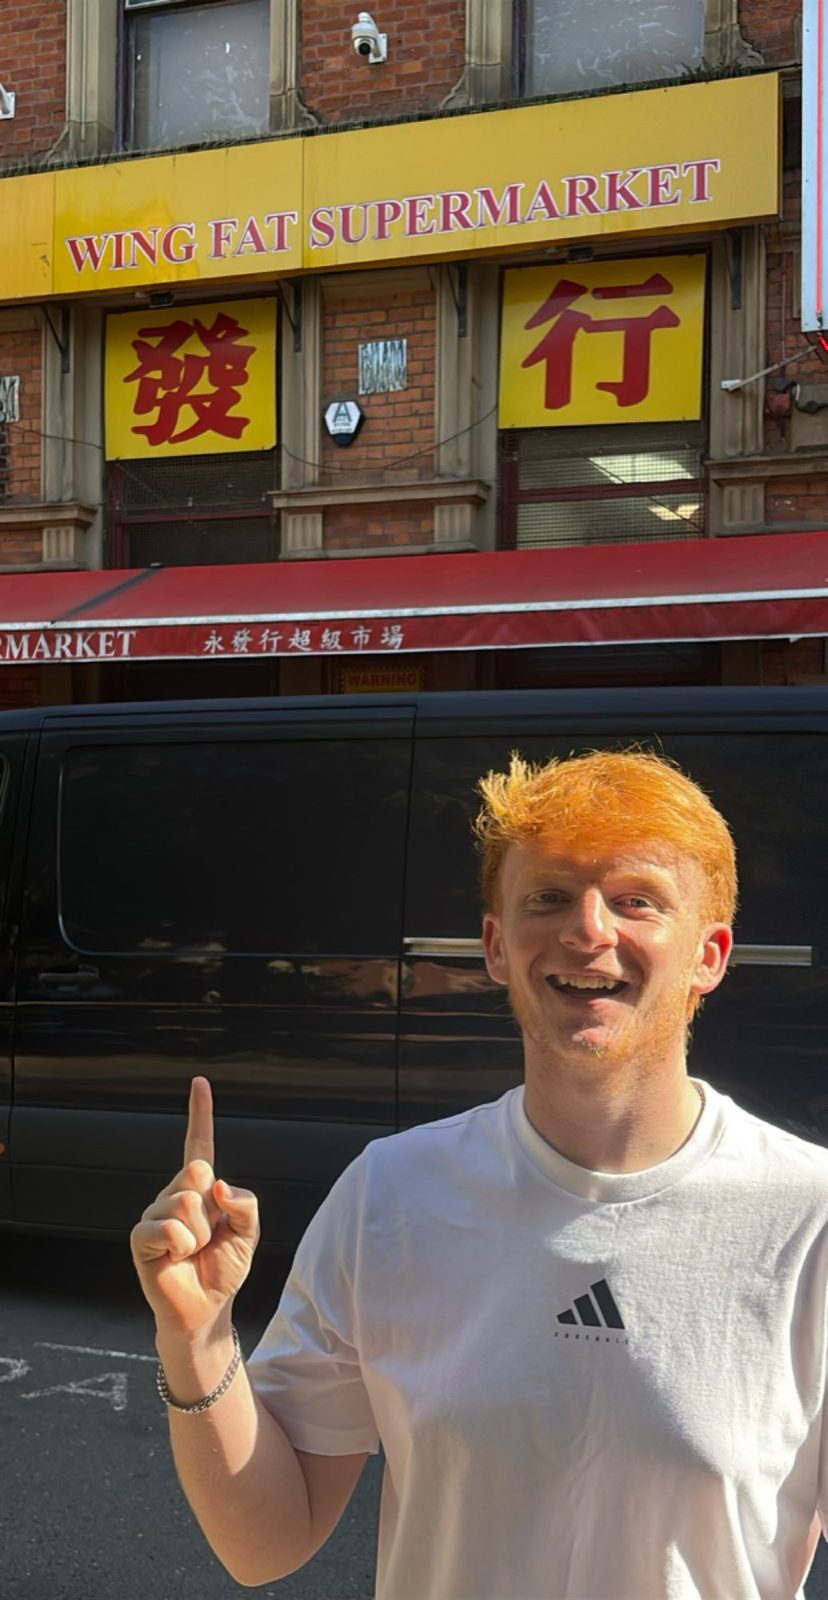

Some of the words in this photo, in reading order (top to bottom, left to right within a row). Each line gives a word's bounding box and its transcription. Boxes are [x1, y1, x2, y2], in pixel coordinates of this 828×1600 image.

[66, 223, 198, 273] WING
[208, 211, 298, 260] FAT
[310, 159, 720, 248] SUPERMARKET
[521, 273, 680, 409] 行
[123, 313, 256, 446] 發
[332, 402, 352, 422] A
[0, 630, 137, 660] MARKET
[203, 625, 405, 655] 永發行超級市場
